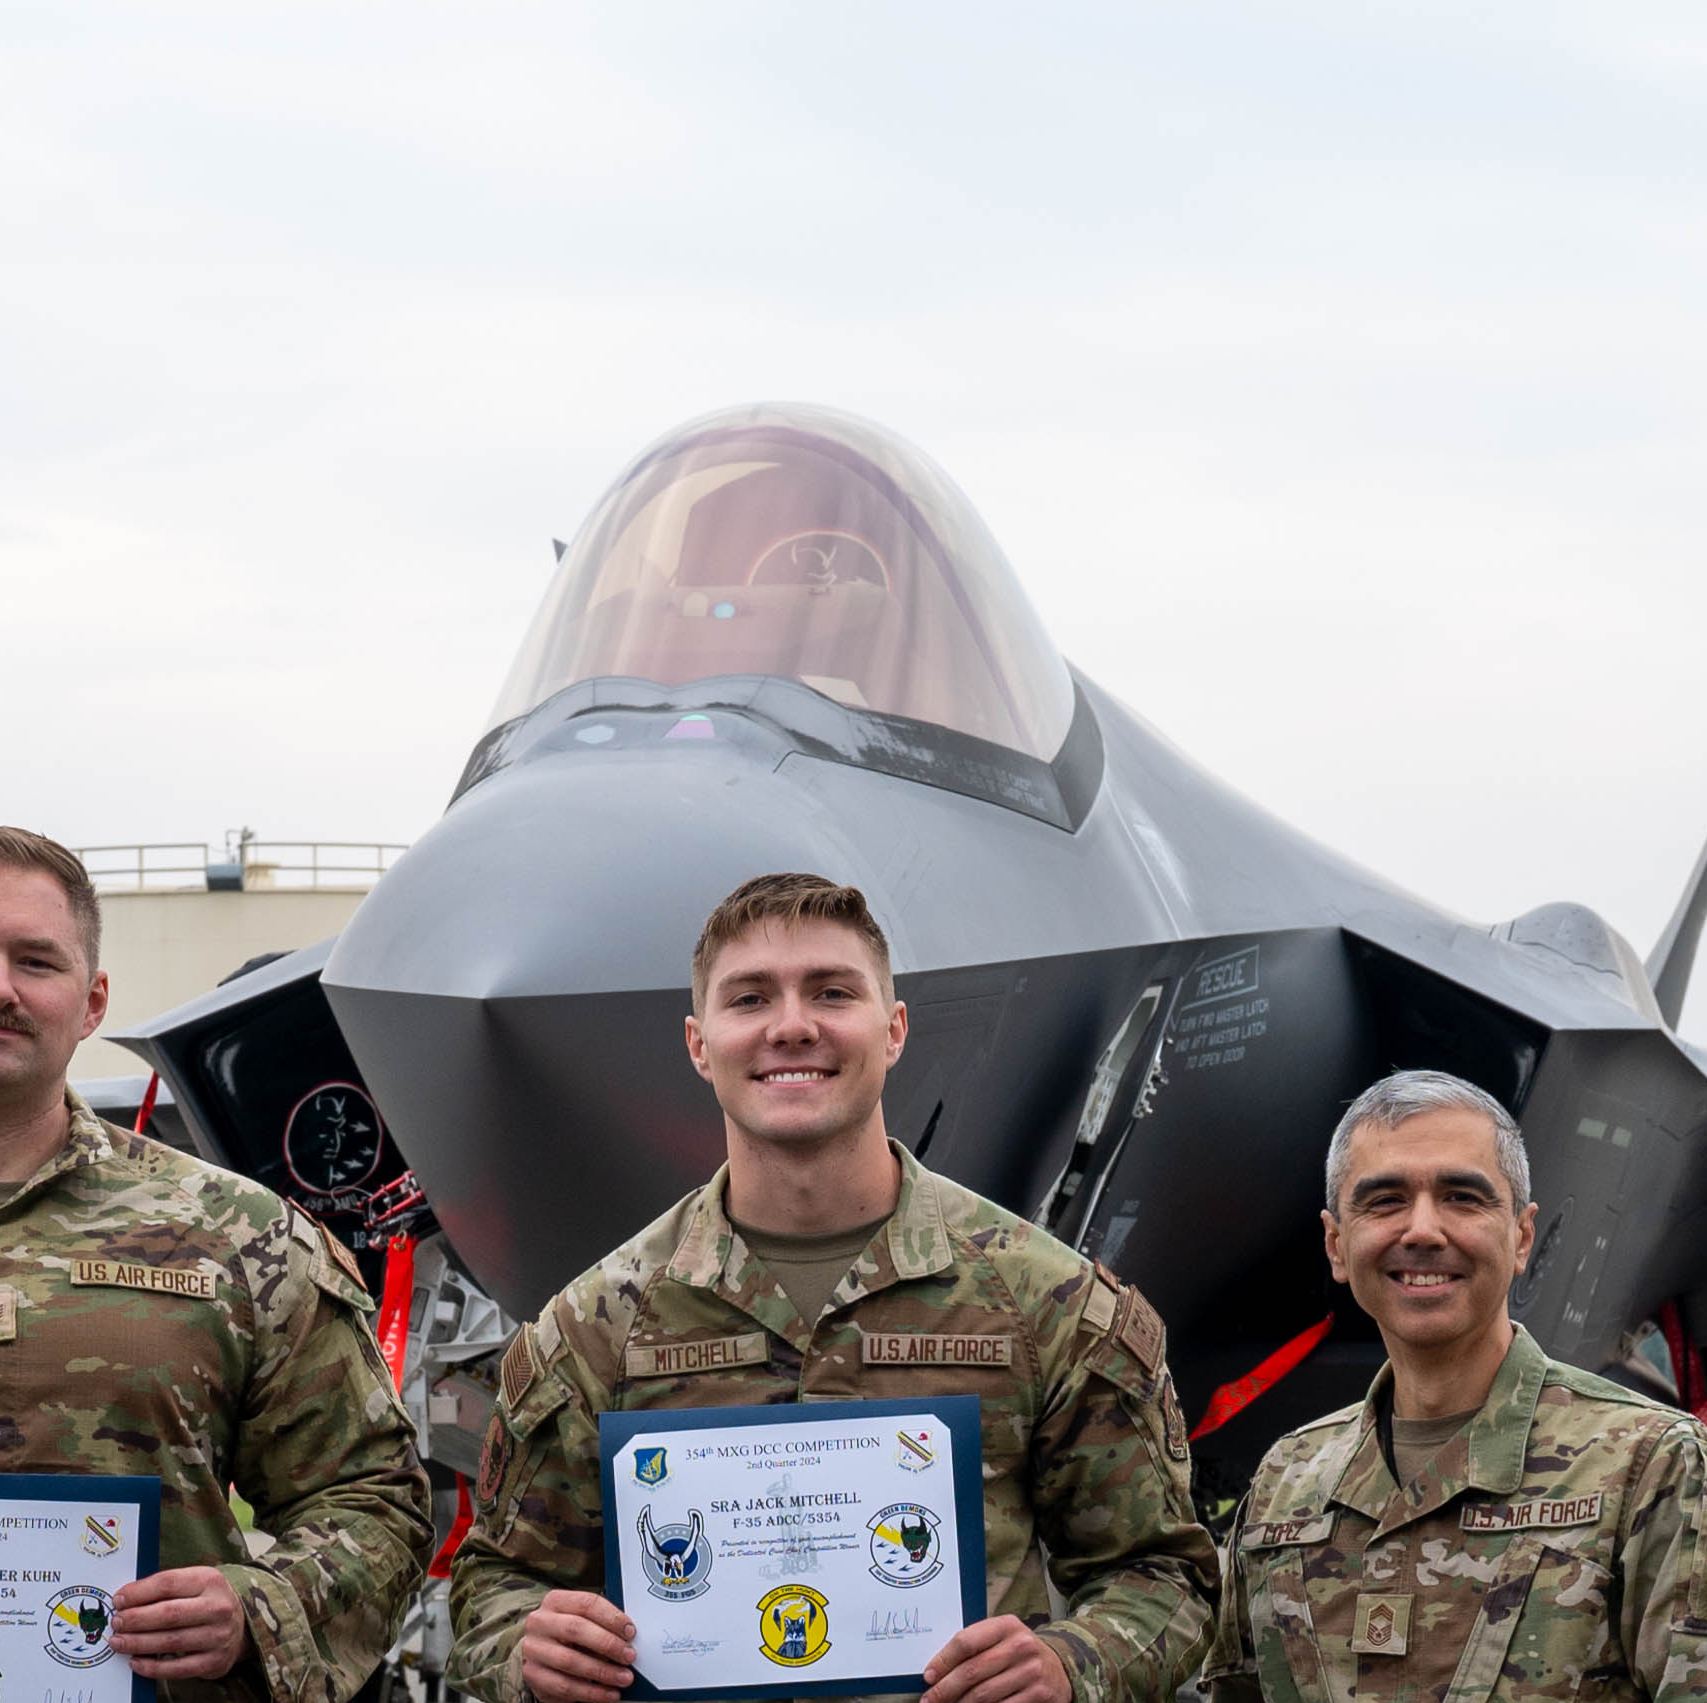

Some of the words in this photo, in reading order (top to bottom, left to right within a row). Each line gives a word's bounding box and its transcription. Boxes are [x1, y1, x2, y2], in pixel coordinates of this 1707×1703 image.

[1195, 958, 1247, 999] RESCUE
[79, 1264, 110, 1283] U.S.
[115, 1266, 147, 1287] AIR
[150, 1269, 211, 1296] FORCE
[654, 1340, 744, 1372] MITCHELL
[869, 1337, 905, 1361] U.S.
[907, 1337, 937, 1361] AIR
[942, 1339, 1005, 1363] FORCE
[686, 1447, 714, 1460] 354th
[717, 1445, 749, 1458] MXG
[753, 1443, 782, 1455] DCC
[785, 1437, 881, 1453] COMPETITION
[746, 1461, 763, 1469] 2nd
[764, 1458, 797, 1469] Quarter
[799, 1456, 821, 1466] 2024
[711, 1501, 741, 1513] SRA
[745, 1496, 784, 1510] JACK
[790, 1492, 861, 1507] MITCHELL
[1463, 1503, 1495, 1529] U.S.
[1508, 1501, 1536, 1526] AIR
[1538, 1495, 1599, 1522] FORCE
[733, 1517, 762, 1528] F-35
[765, 1512, 841, 1527] ADCC/5354
[1261, 1520, 1303, 1545] LOPEZ
[22, 1570, 62, 1583] KUHN
